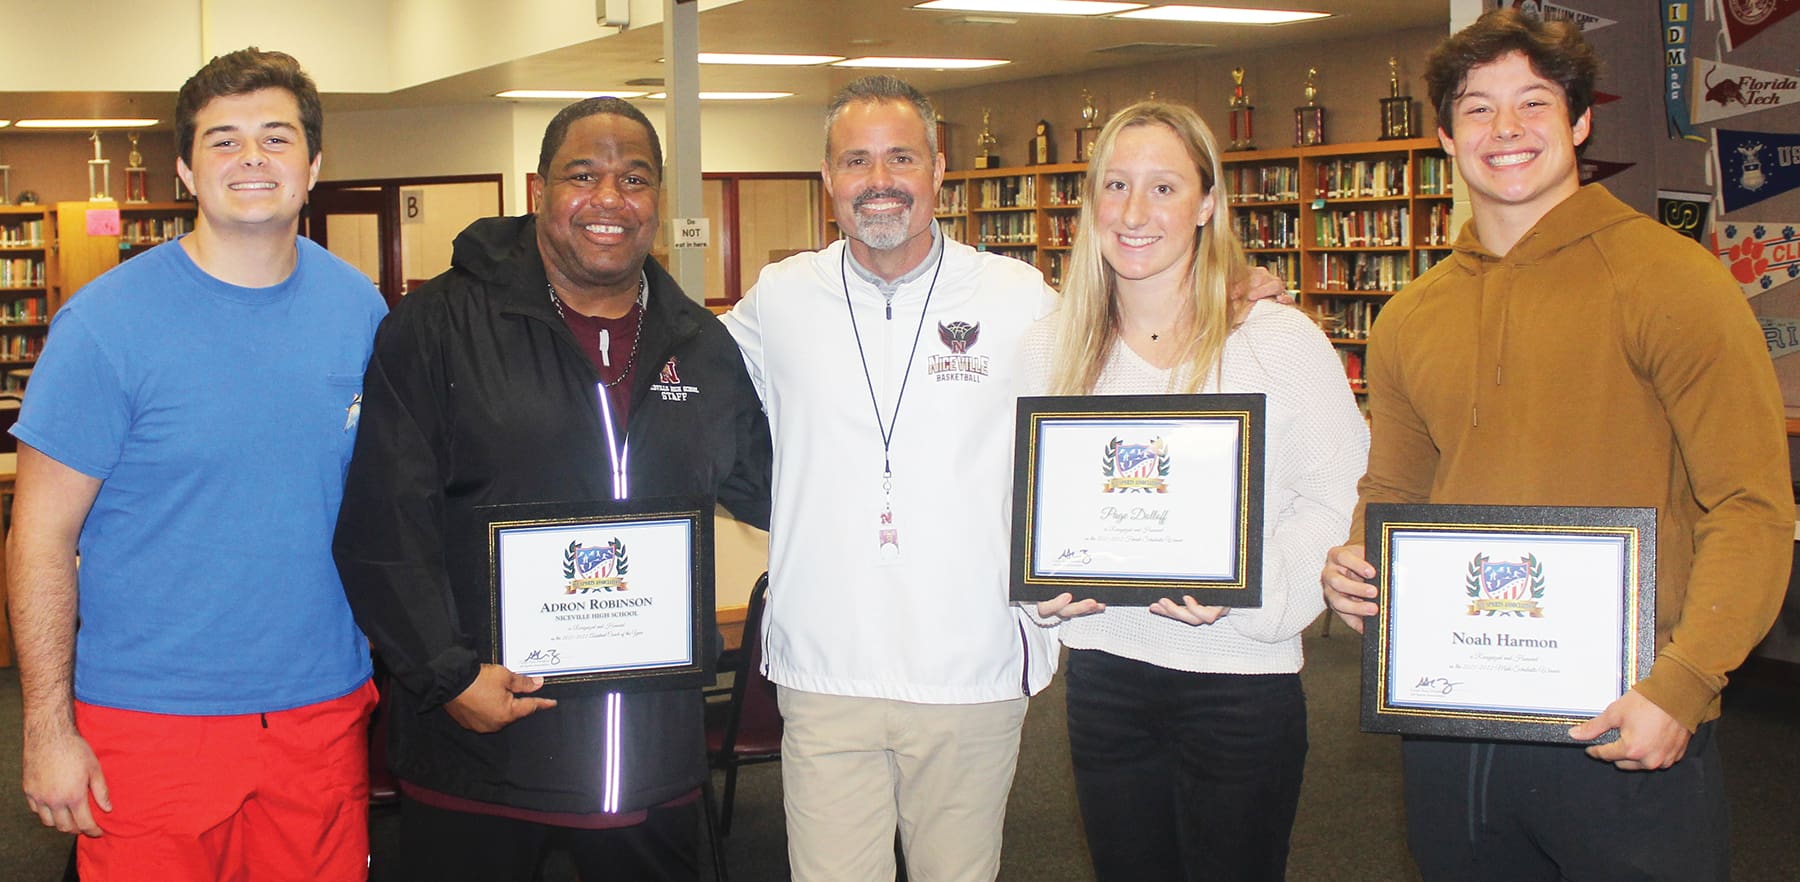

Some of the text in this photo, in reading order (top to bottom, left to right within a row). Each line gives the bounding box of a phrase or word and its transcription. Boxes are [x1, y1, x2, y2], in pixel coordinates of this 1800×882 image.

[1739, 76, 1798, 91] Florida
[1746, 90, 1781, 105] Tech
[407, 196, 419, 218] B
[682, 228, 701, 237] NOT
[1773, 240, 1800, 262] CL
[952, 340, 967, 354] N
[660, 361, 680, 384] N
[928, 354, 990, 376] NICEVILLE
[936, 373, 981, 383] BASKETBALL
[661, 391, 688, 401] STAFF
[1100, 506, 1128, 523] Paige
[541, 597, 653, 613] ADRON ROBINSON
[555, 613, 590, 621] NICEVILLE
[611, 610, 638, 618] SCHOOL
[1452, 631, 1558, 649] Noah Harmon
